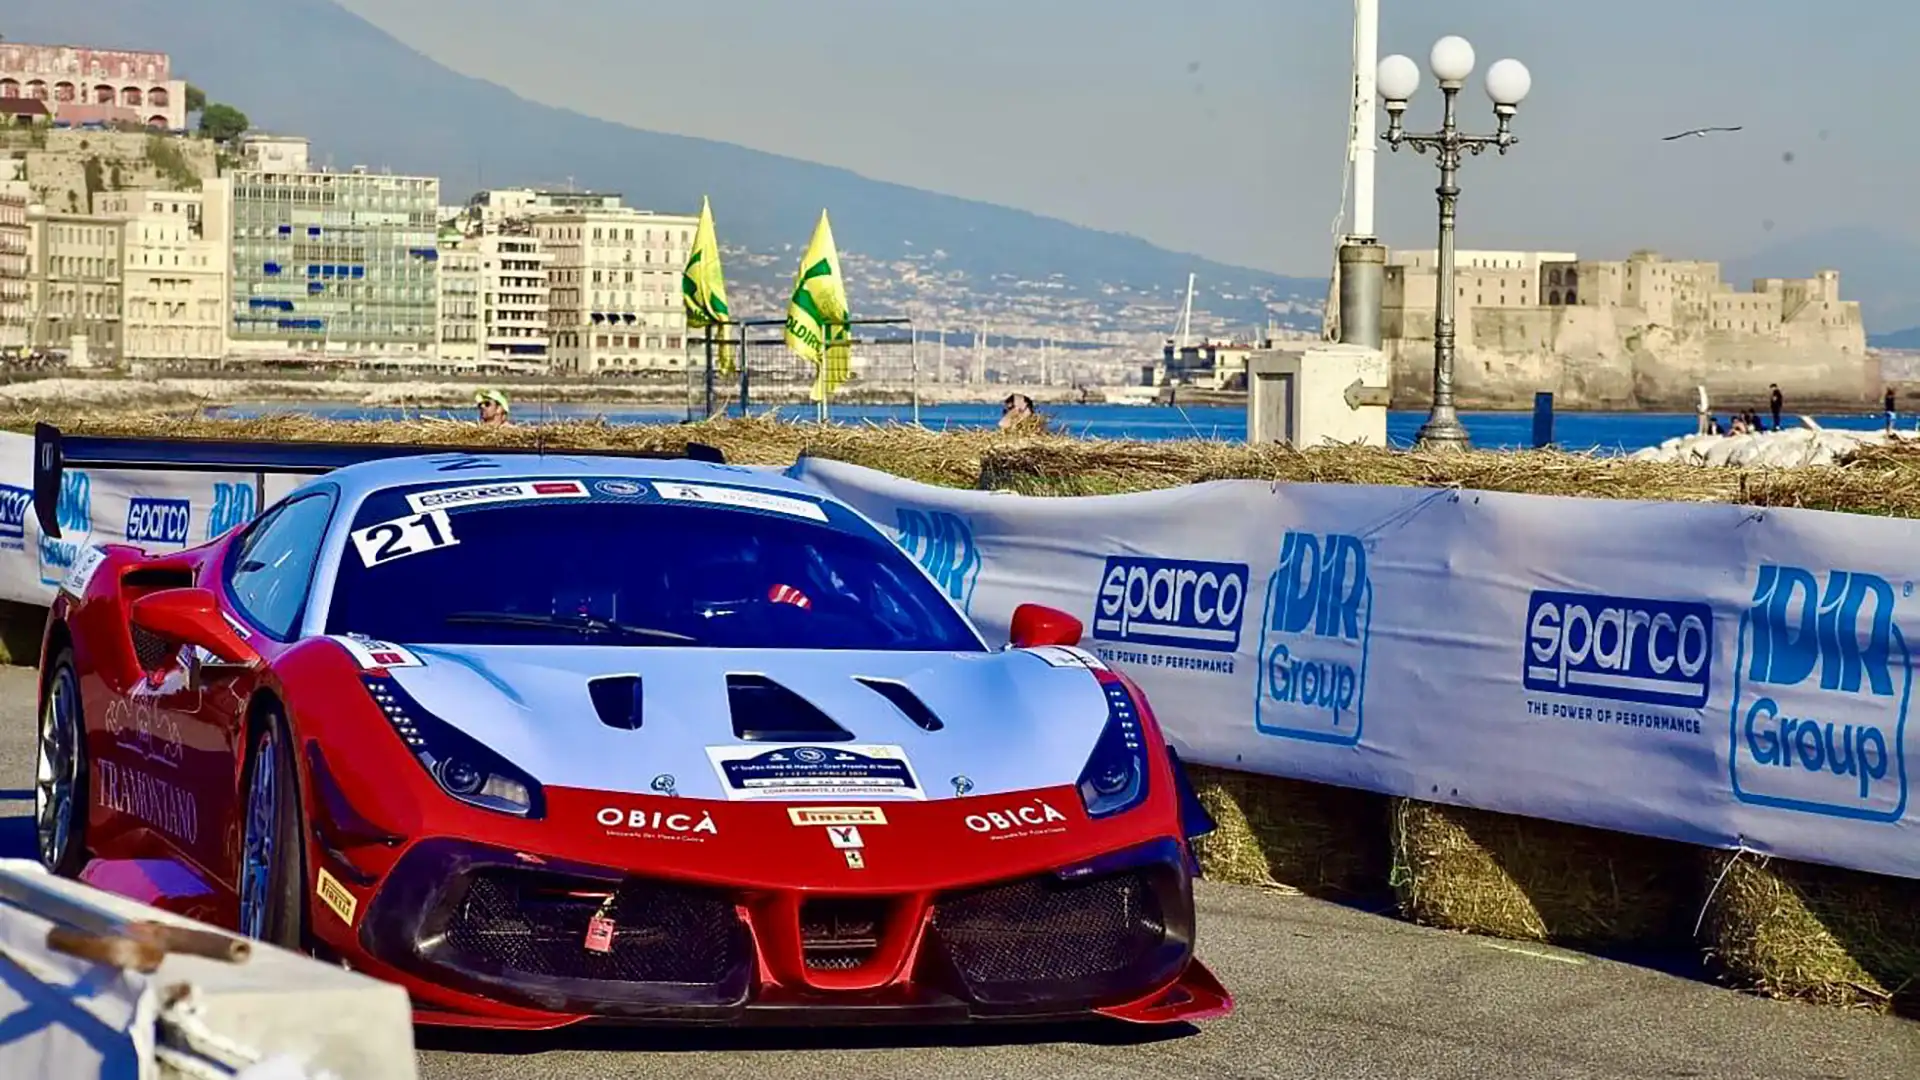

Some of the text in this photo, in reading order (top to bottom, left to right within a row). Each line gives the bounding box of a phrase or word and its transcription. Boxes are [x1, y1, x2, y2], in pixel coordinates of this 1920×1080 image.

[129, 503, 188, 544] sparco
[366, 513, 445, 562] 21
[1102, 565, 1243, 638] sparco
[1097, 648, 1114, 661] THE
[1117, 651, 1148, 665] POWER
[1151, 654, 1163, 666] OF
[1165, 656, 1234, 674] PERFORMANCE
[1531, 602, 1707, 688] sparco
[1269, 644, 1355, 725] Group
[1527, 700, 1700, 734] THE POWER OF PERFORMANCE
[1745, 698, 1888, 798] Group
[98, 757, 198, 845] TRAMONTANO
[597, 807, 718, 835] OBICÀ
[965, 798, 1067, 832] OBICÀ
[320, 876, 352, 917] PIRELLI
